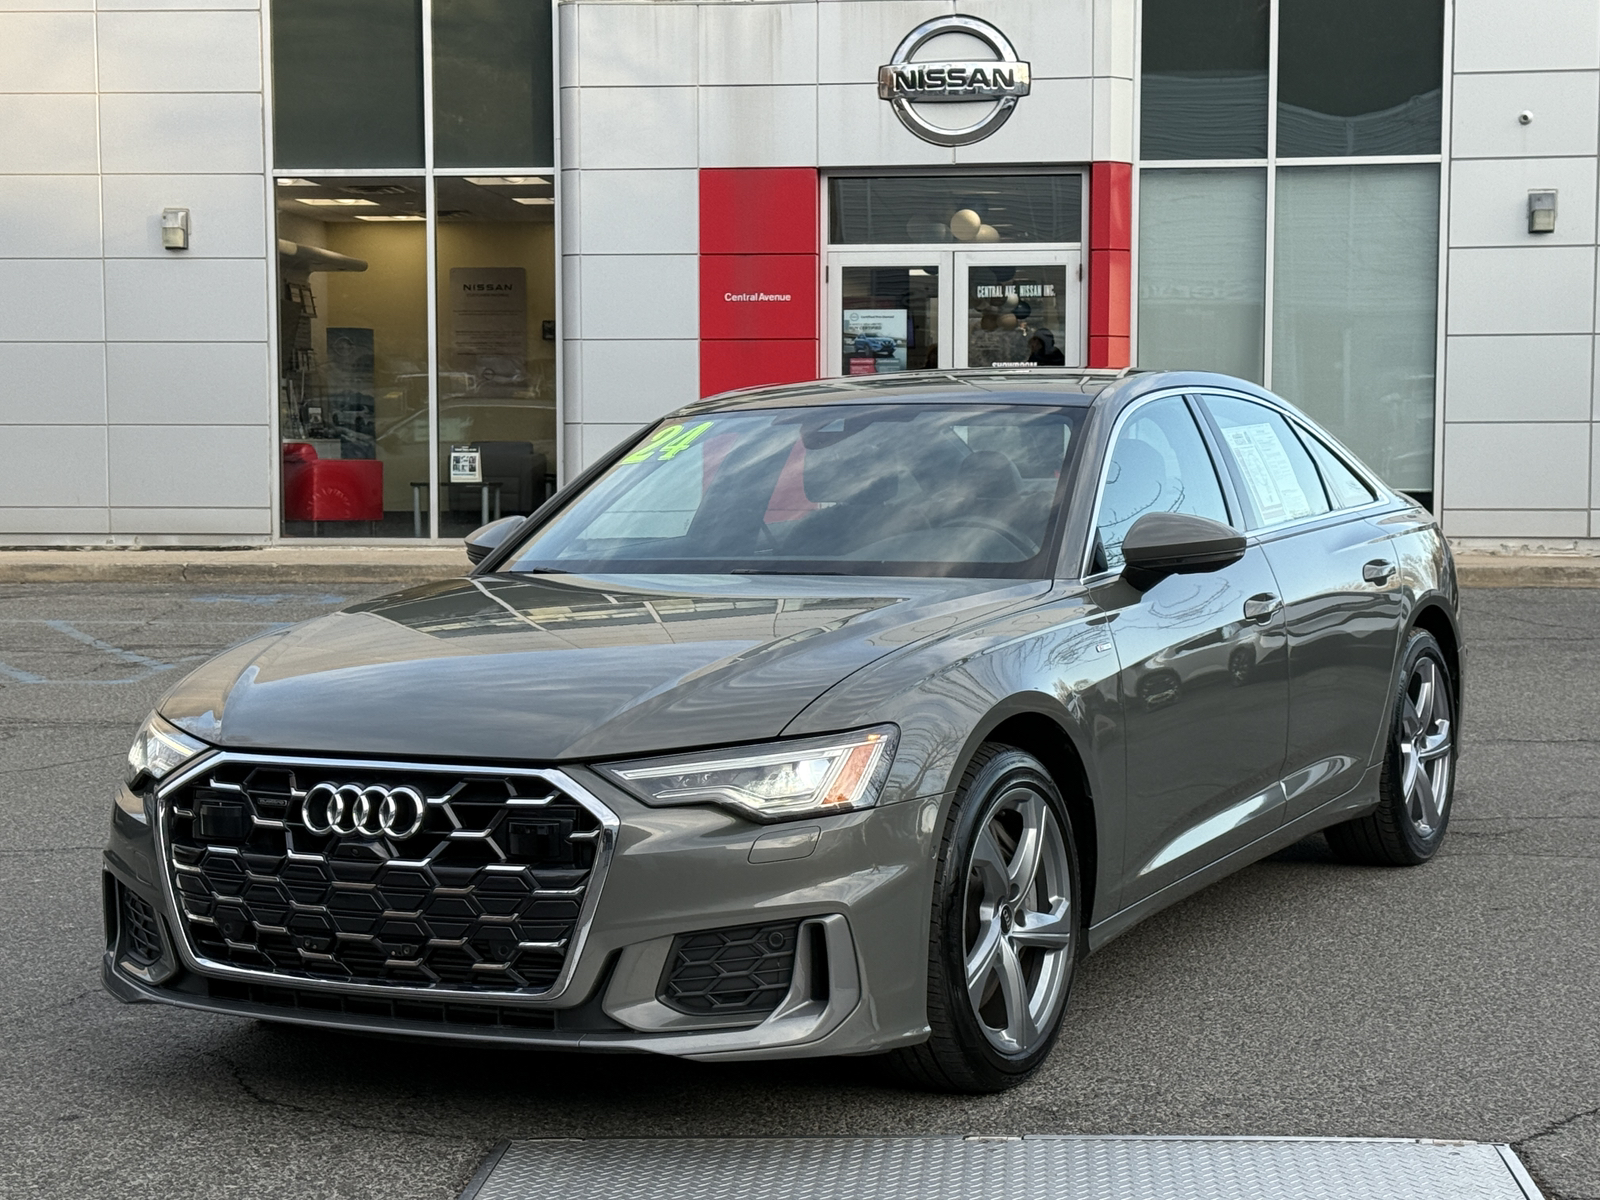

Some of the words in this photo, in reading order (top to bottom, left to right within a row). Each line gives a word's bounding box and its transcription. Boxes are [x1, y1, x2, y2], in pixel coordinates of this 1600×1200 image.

[894, 68, 1015, 91] NISSAN
[724, 292, 758, 301] Central
[758, 292, 792, 301] Avenue
[977, 285, 1003, 298] CENTRAL
[1019, 284, 1042, 297] NISSAN
[620, 421, 714, 465] 24
